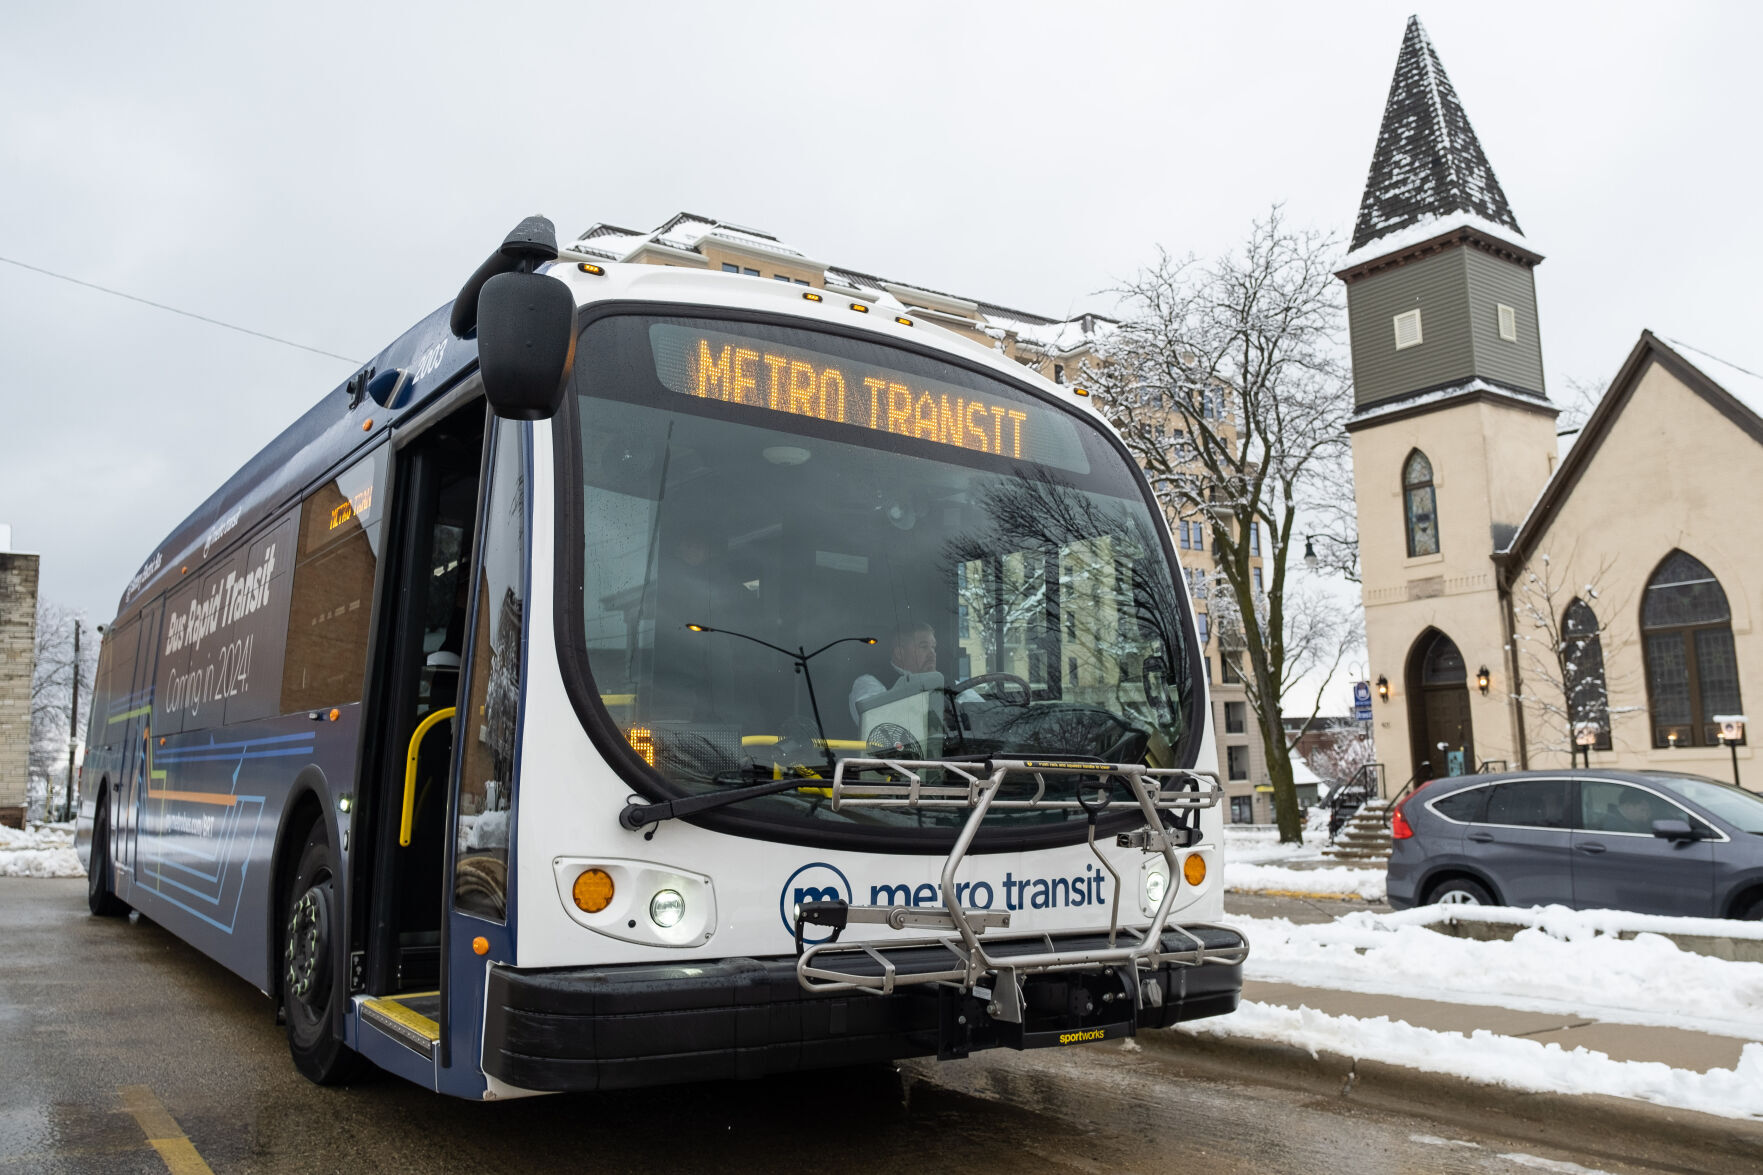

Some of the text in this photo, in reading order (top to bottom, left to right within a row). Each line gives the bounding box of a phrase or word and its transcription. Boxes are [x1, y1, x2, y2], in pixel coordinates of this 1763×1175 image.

[412, 338, 448, 386] 2003
[698, 340, 1027, 459] METRO TRANSIT
[165, 543, 276, 656] Bus Rapid Transit
[165, 633, 254, 717] Coming in 2024!
[870, 881, 994, 910] mero
[1002, 863, 1105, 911] transit
[1059, 1028, 1105, 1044] sportworks
